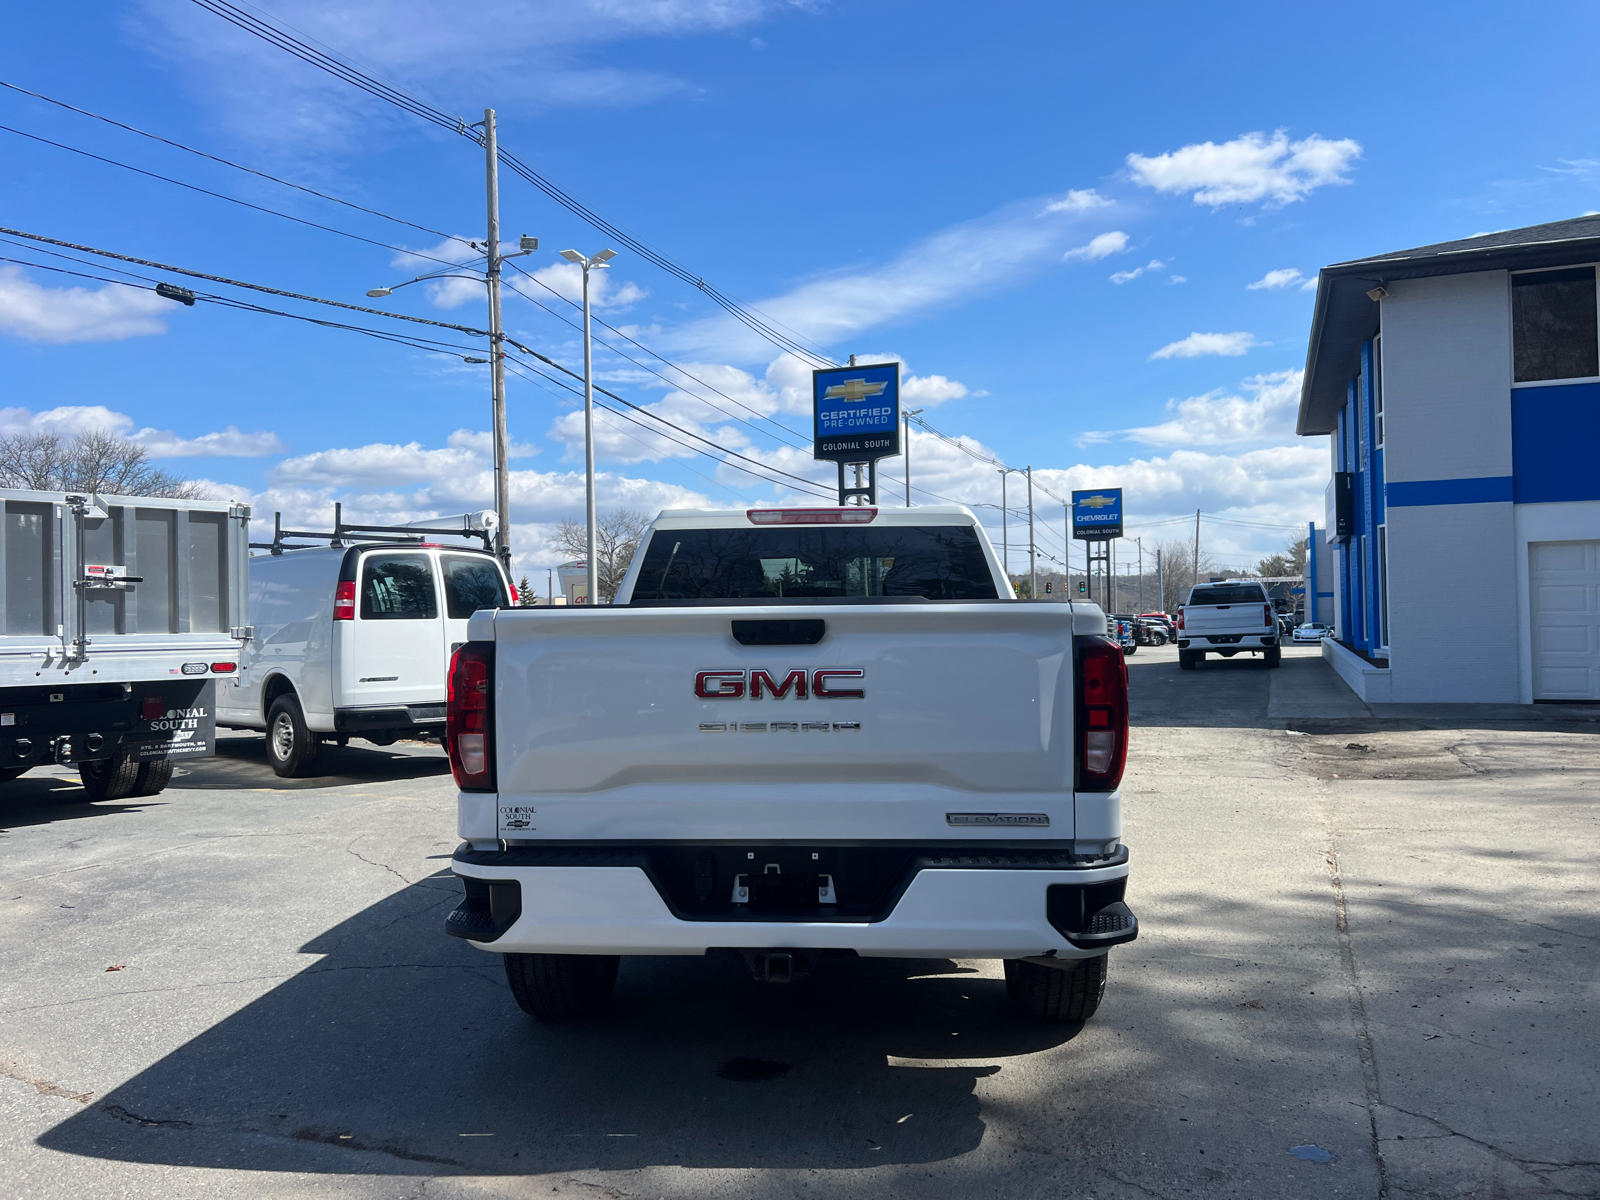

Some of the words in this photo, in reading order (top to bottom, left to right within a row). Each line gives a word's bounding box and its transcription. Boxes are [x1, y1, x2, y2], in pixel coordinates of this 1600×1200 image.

[820, 407, 892, 420] CERTIFIED
[824, 416, 888, 428] PRE-OWNED
[822, 441, 860, 451] COLONIAL
[864, 439, 890, 448] SOUTH
[1076, 513, 1119, 522] CHEVROLET
[694, 668, 866, 700] GMC
[141, 707, 208, 720] ONIAL
[150, 718, 198, 731] SOUTH
[698, 721, 861, 732] SIERRA
[952, 815, 1043, 825] ELEVATION
